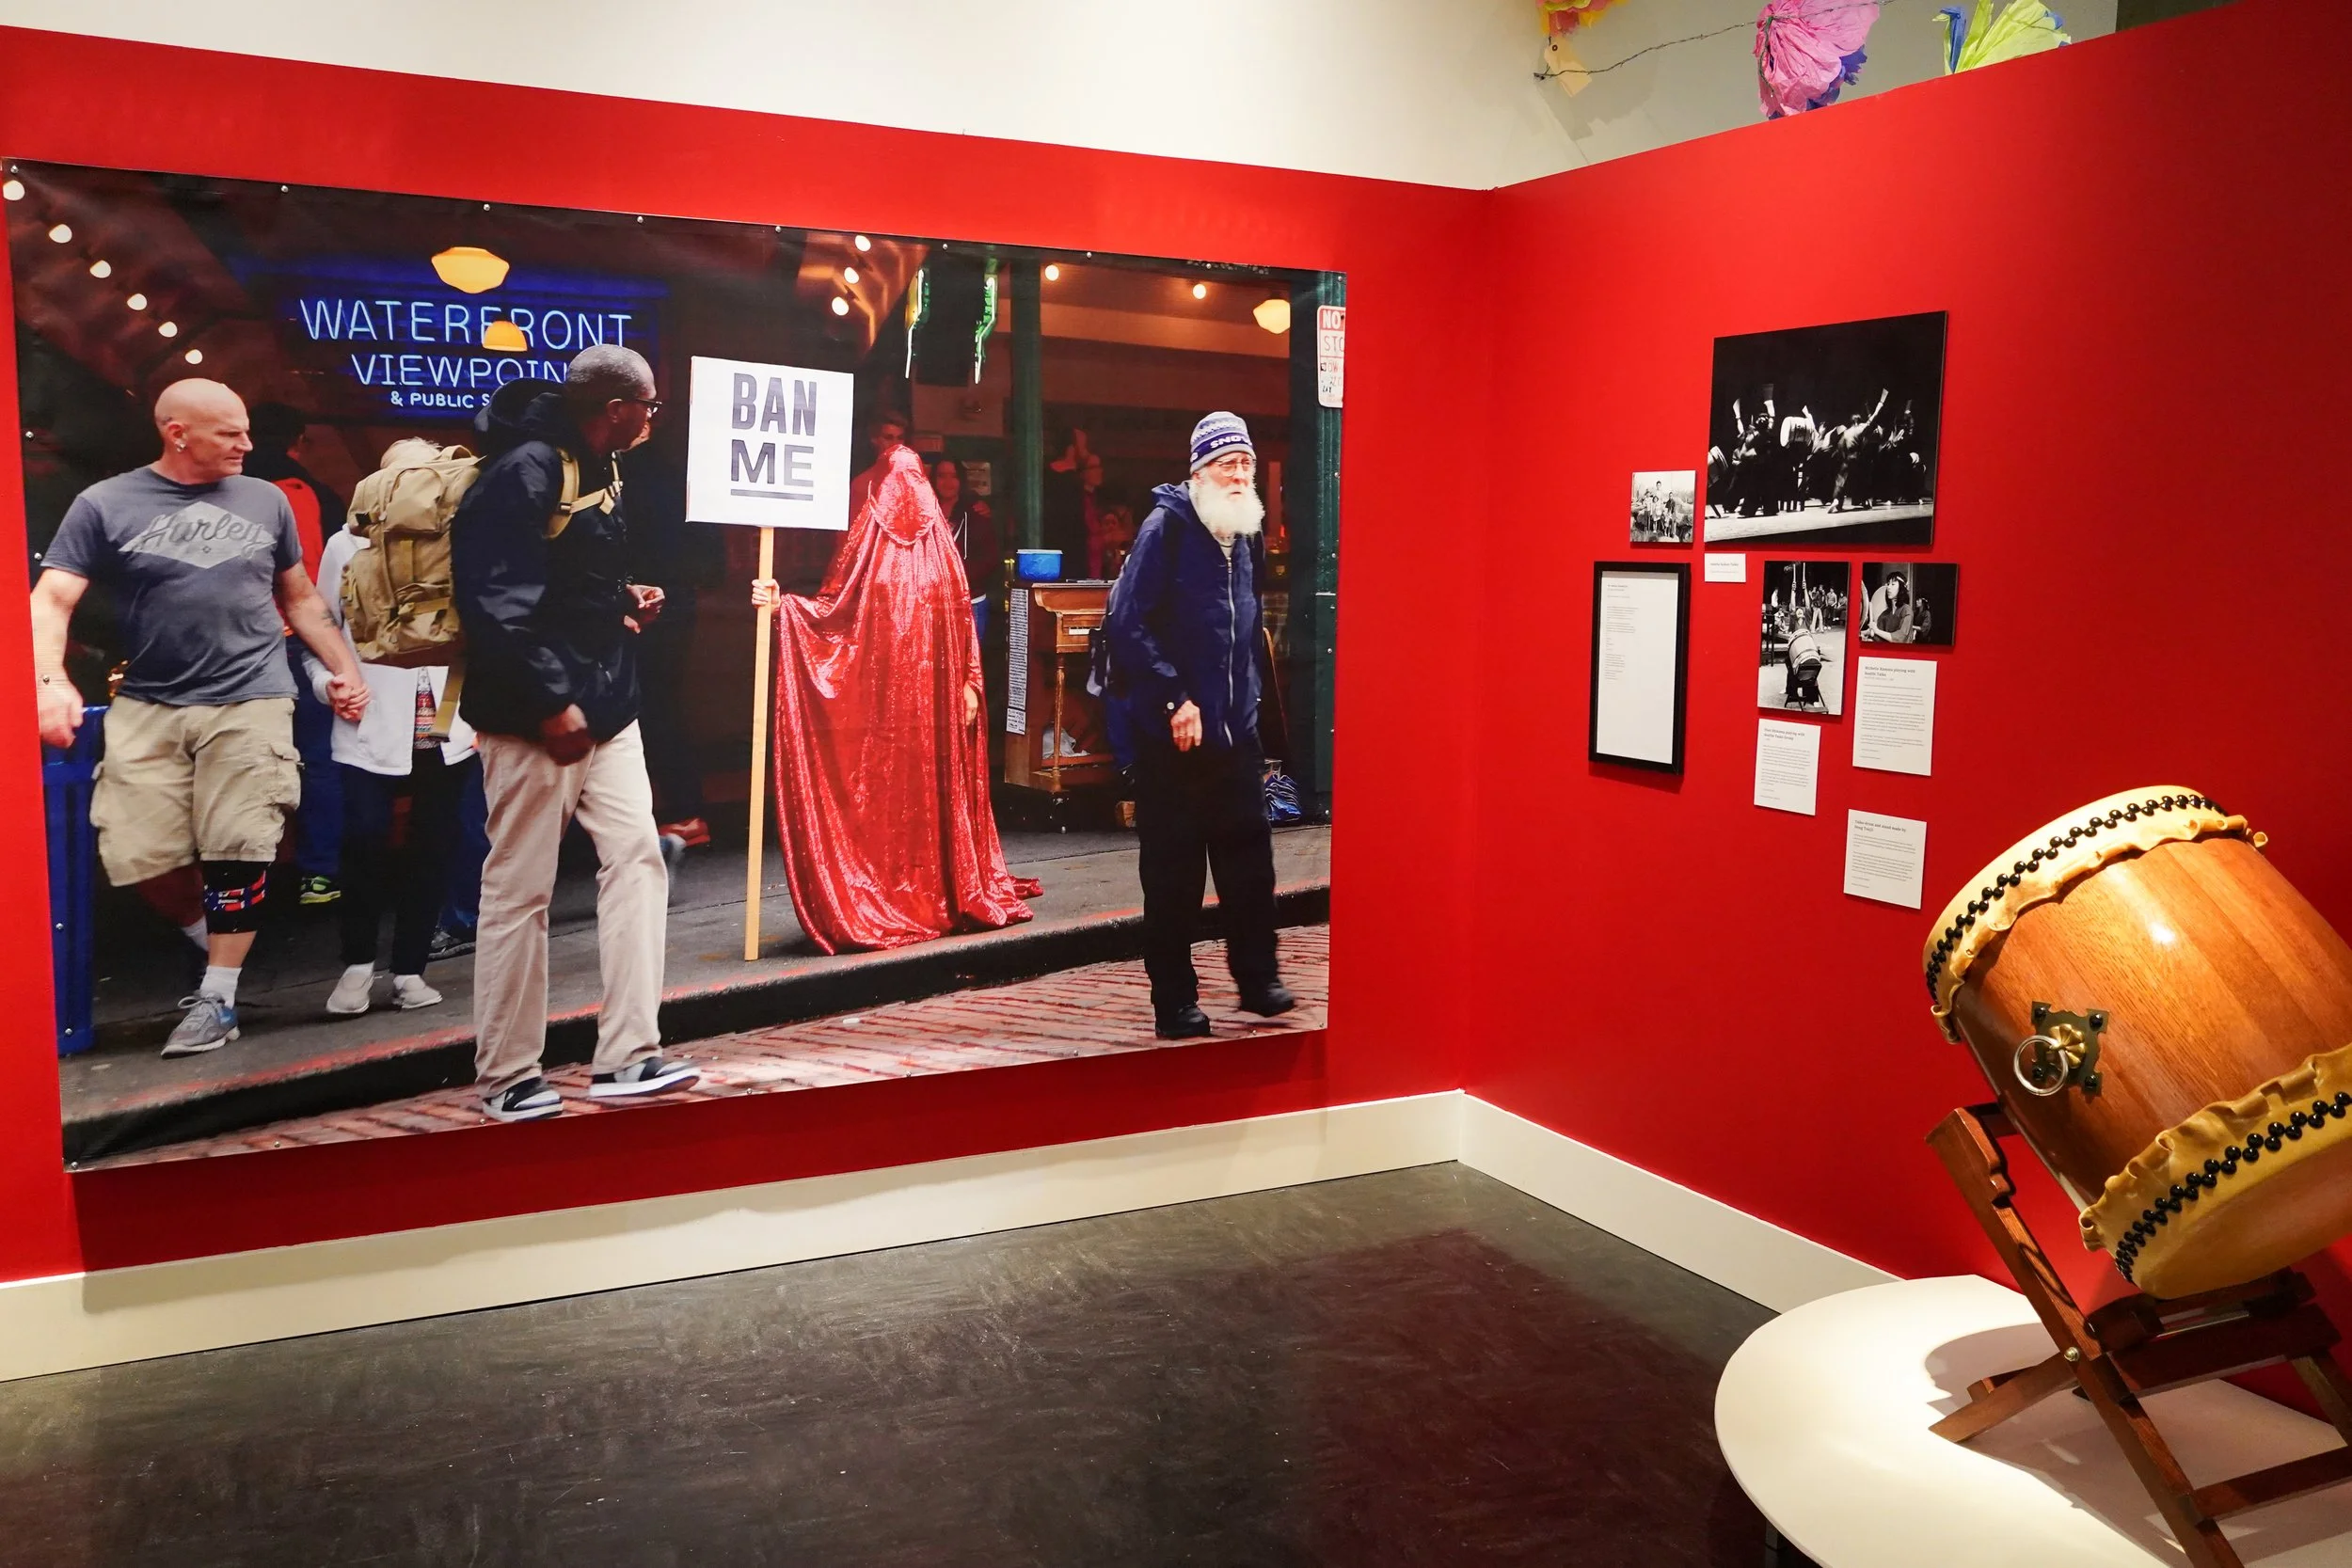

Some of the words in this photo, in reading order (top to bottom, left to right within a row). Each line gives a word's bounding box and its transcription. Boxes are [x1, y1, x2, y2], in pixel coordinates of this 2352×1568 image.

[300, 298, 632, 350] WATERFRONT
[351, 354, 567, 388] VIEWPOIN
[410, 392, 474, 408] PUBLIC
[731, 372, 817, 436] BAN
[731, 439, 814, 487] ME
